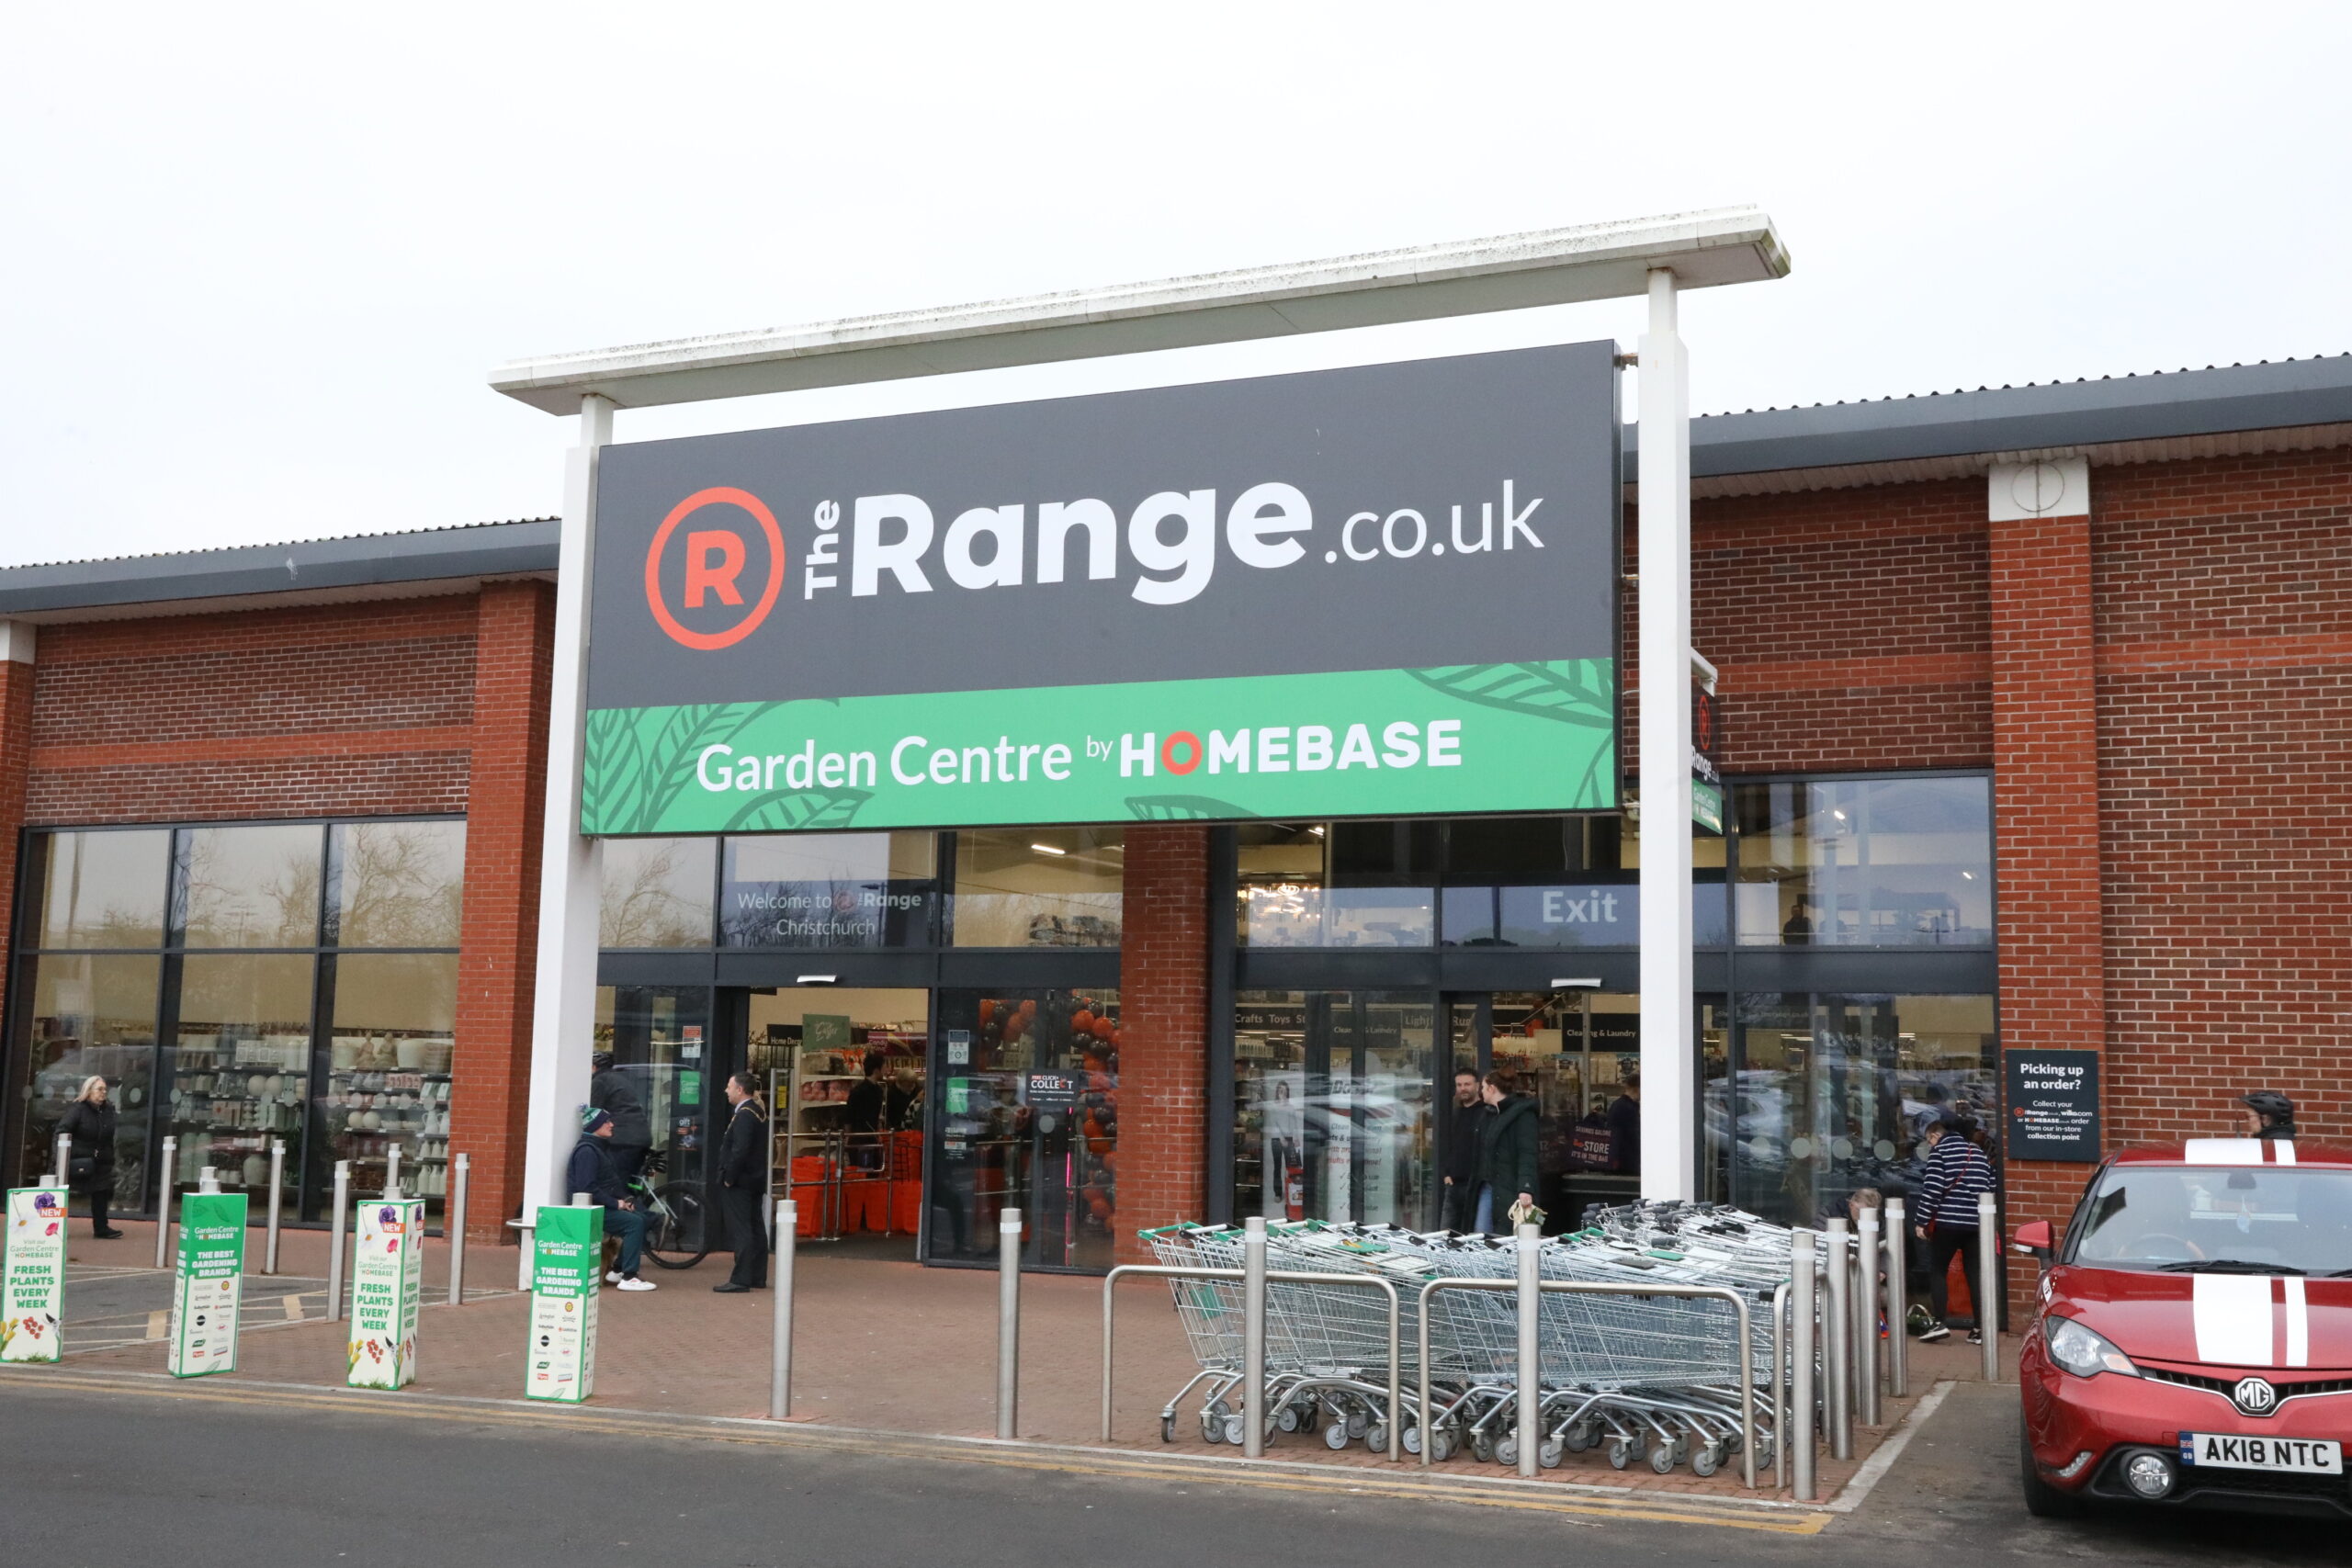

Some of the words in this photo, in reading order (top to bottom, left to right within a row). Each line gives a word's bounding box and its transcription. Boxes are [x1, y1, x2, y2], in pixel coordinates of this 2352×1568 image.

[804, 499, 841, 600] The
[851, 482, 1313, 605] Range
[695, 739, 876, 793] Garden
[889, 735, 1072, 785] Centre
[1086, 736, 1114, 761] by
[1119, 718, 1462, 778] HOMEBASE
[738, 892, 812, 909] Welcome
[816, 896, 832, 908] to
[863, 892, 922, 910] Range
[1543, 889, 1619, 923] Exit
[776, 919, 876, 936] Christchurch
[1235, 1013, 1263, 1024] Crafts
[1268, 1014, 1291, 1025] Toys
[1405, 1015, 1434, 1030] Lighti
[1566, 1029, 1599, 1038] Cleang
[1606, 1029, 1636, 1039] Laundry
[770, 1036, 787, 1045] Home
[2020, 1063, 2066, 1077] Picking
[2067, 1066, 2084, 1077] up
[1031, 1078, 1074, 1089] COLLECT
[2023, 1080, 2039, 1089] an
[2041, 1079, 2082, 1090] order?
[2062, 1134, 2080, 1142] point
[1583, 1141, 1611, 1155] STORE
[40, 1208, 62, 1217] NEW
[383, 1224, 401, 1233] NEW
[537, 1240, 560, 1248] Garden
[560, 1241, 583, 1250] Centre
[213, 1250, 235, 1258] BEST
[542, 1248, 578, 1257] HOMEBASE
[192, 1258, 238, 1268] GARDENING
[14, 1266, 51, 1274] FRESH
[198, 1268, 232, 1277] BRANDS
[541, 1267, 557, 1275] THE
[557, 1268, 579, 1277] BEST
[10, 1277, 54, 1285] PLANTS
[536, 1276, 582, 1287] GARDENING
[14, 1288, 51, 1297] EVERY
[361, 1283, 391, 1293] FRESH
[542, 1286, 575, 1296] BRANDS
[17, 1300, 48, 1308] WEEK
[356, 1295, 394, 1306] PLANTS
[359, 1307, 390, 1318] EVERY
[362, 1320, 387, 1330] WEEK
[2241, 1382, 2269, 1408] MG
[2205, 1437, 2266, 1463] AK18
[2274, 1441, 2329, 1468] NTC
